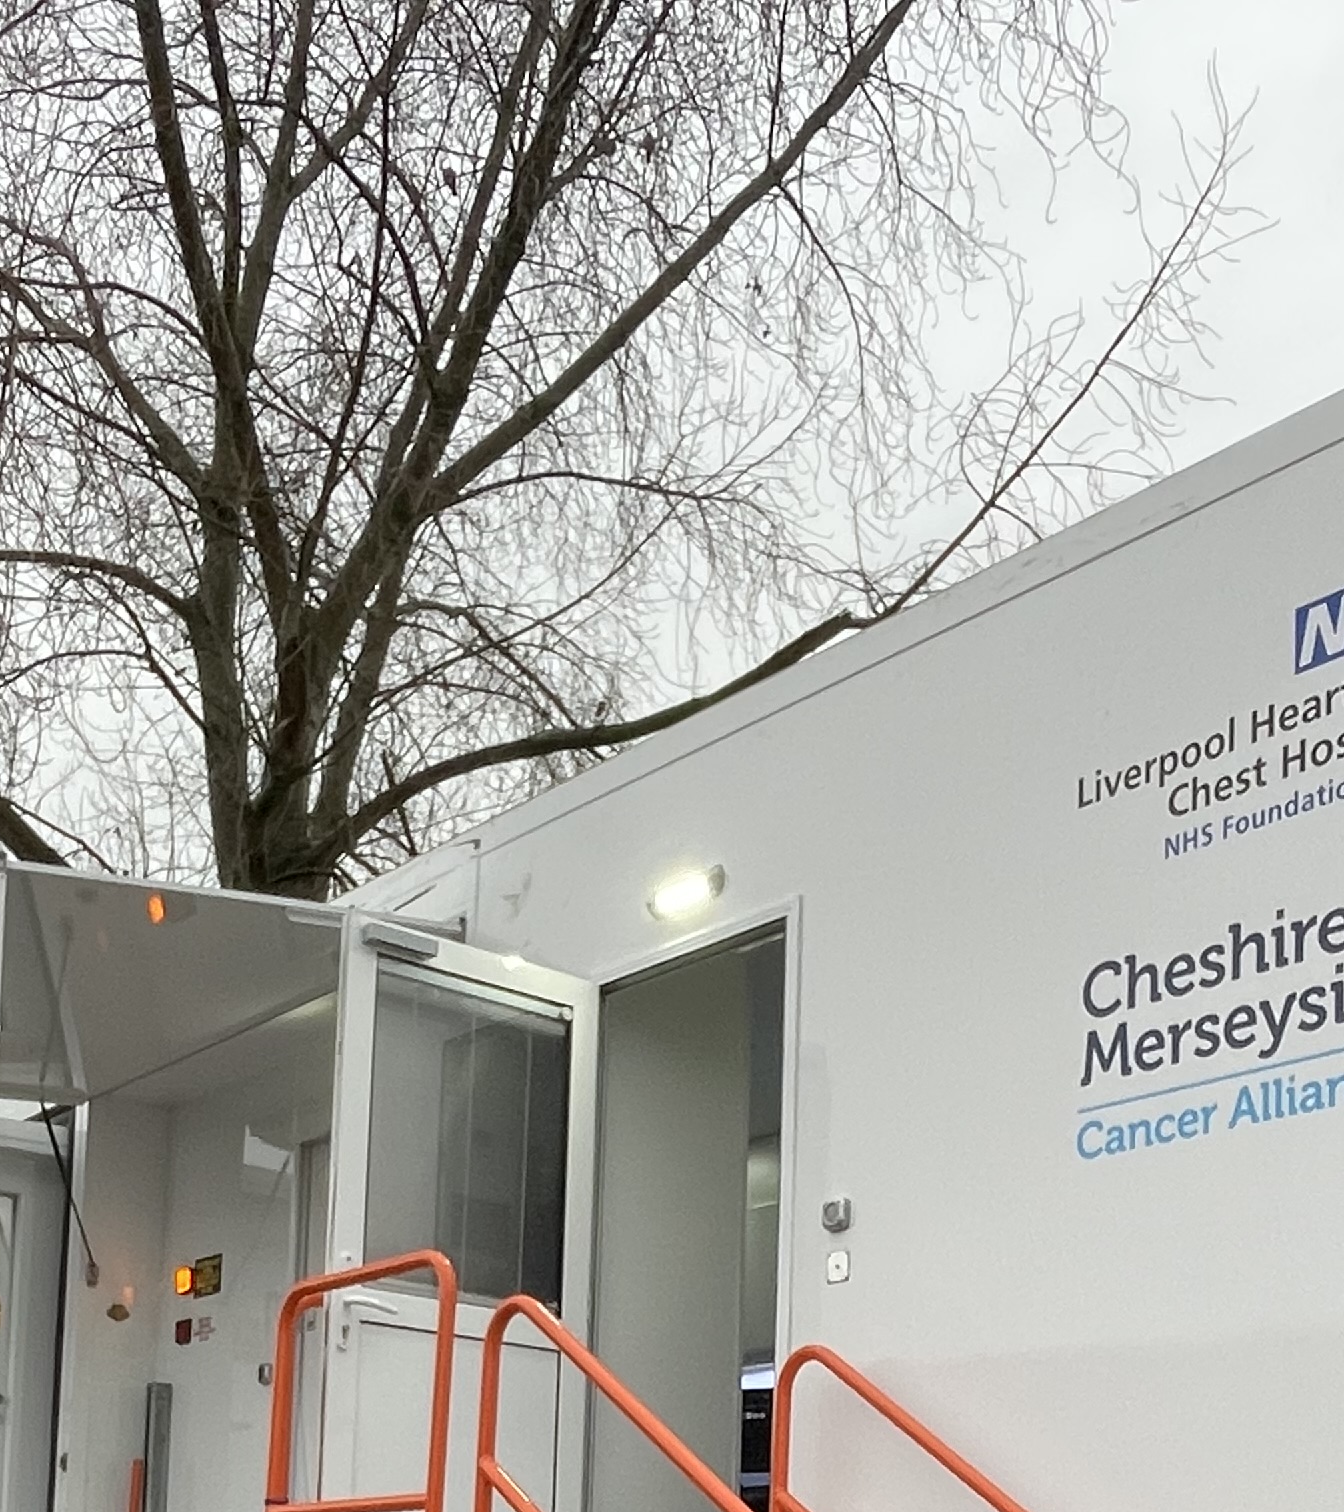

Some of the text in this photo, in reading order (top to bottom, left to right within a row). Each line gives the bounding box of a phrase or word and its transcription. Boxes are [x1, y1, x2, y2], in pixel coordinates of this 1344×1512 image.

[1076, 717, 1236, 810] Liverpool
[1167, 757, 1267, 818] Chest
[1164, 822, 1214, 860] NHS
[1076, 1102, 1219, 1160] Cancer
